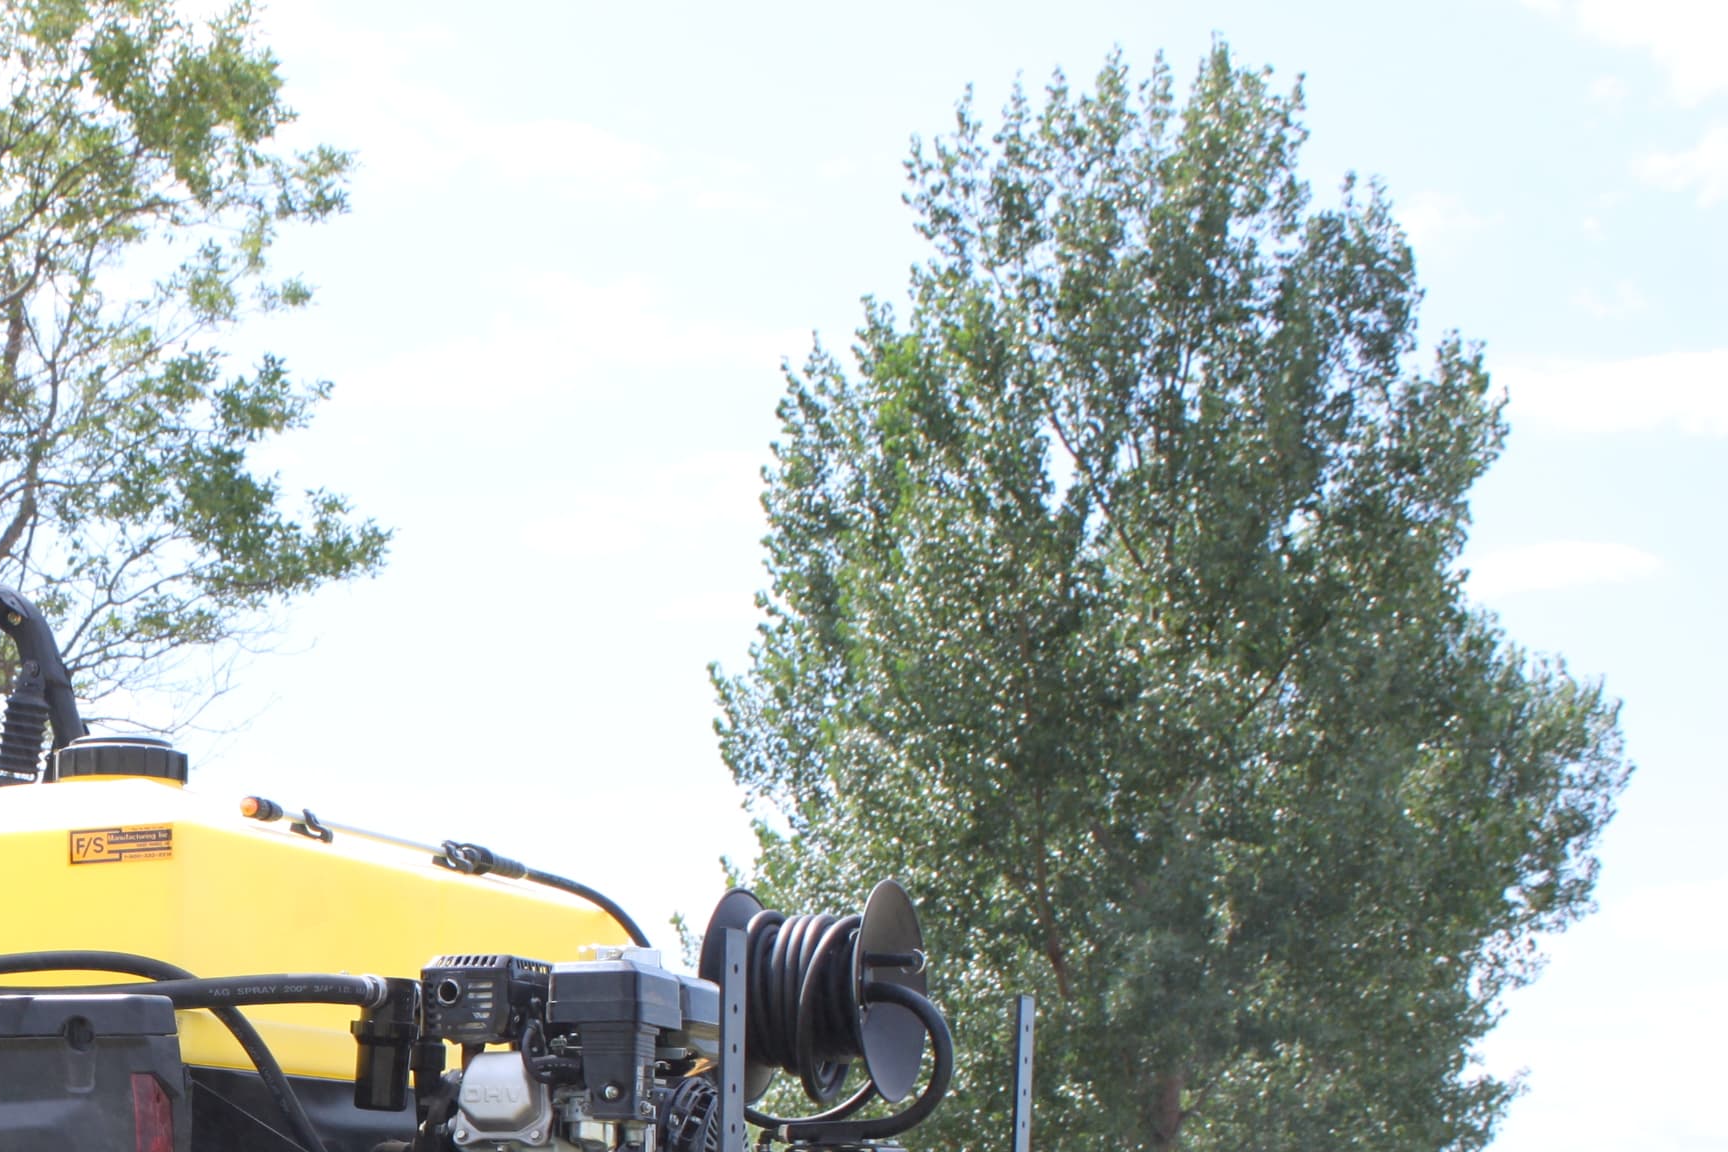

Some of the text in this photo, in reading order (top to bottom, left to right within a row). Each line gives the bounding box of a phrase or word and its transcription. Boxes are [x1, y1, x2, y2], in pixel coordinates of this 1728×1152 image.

[75, 836, 105, 858] F/S
[237, 985, 277, 996] SPRAY
[463, 1083, 523, 1104] OHV
